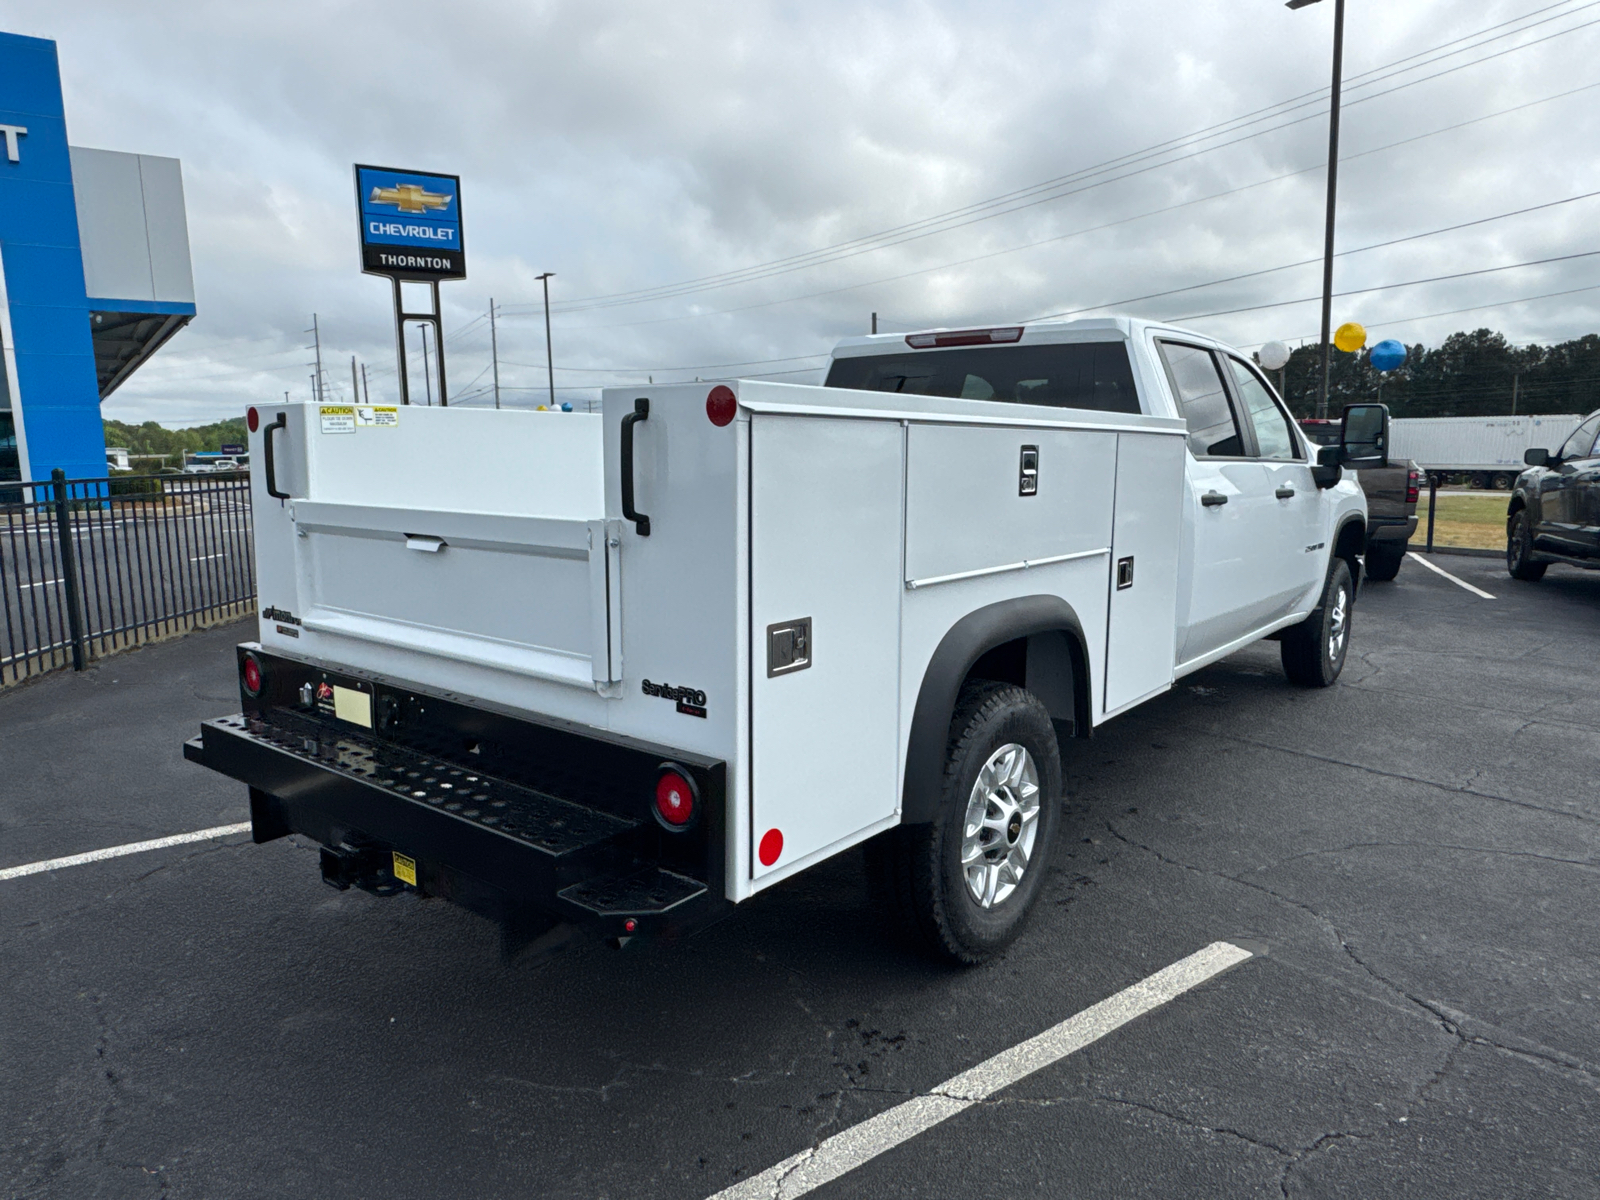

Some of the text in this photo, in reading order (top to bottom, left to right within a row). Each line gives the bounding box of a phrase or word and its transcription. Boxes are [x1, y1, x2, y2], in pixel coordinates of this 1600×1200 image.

[369, 222, 455, 240] CHEVROLET
[380, 254, 452, 269] THORNTON
[641, 679, 707, 706] ServicePRO
